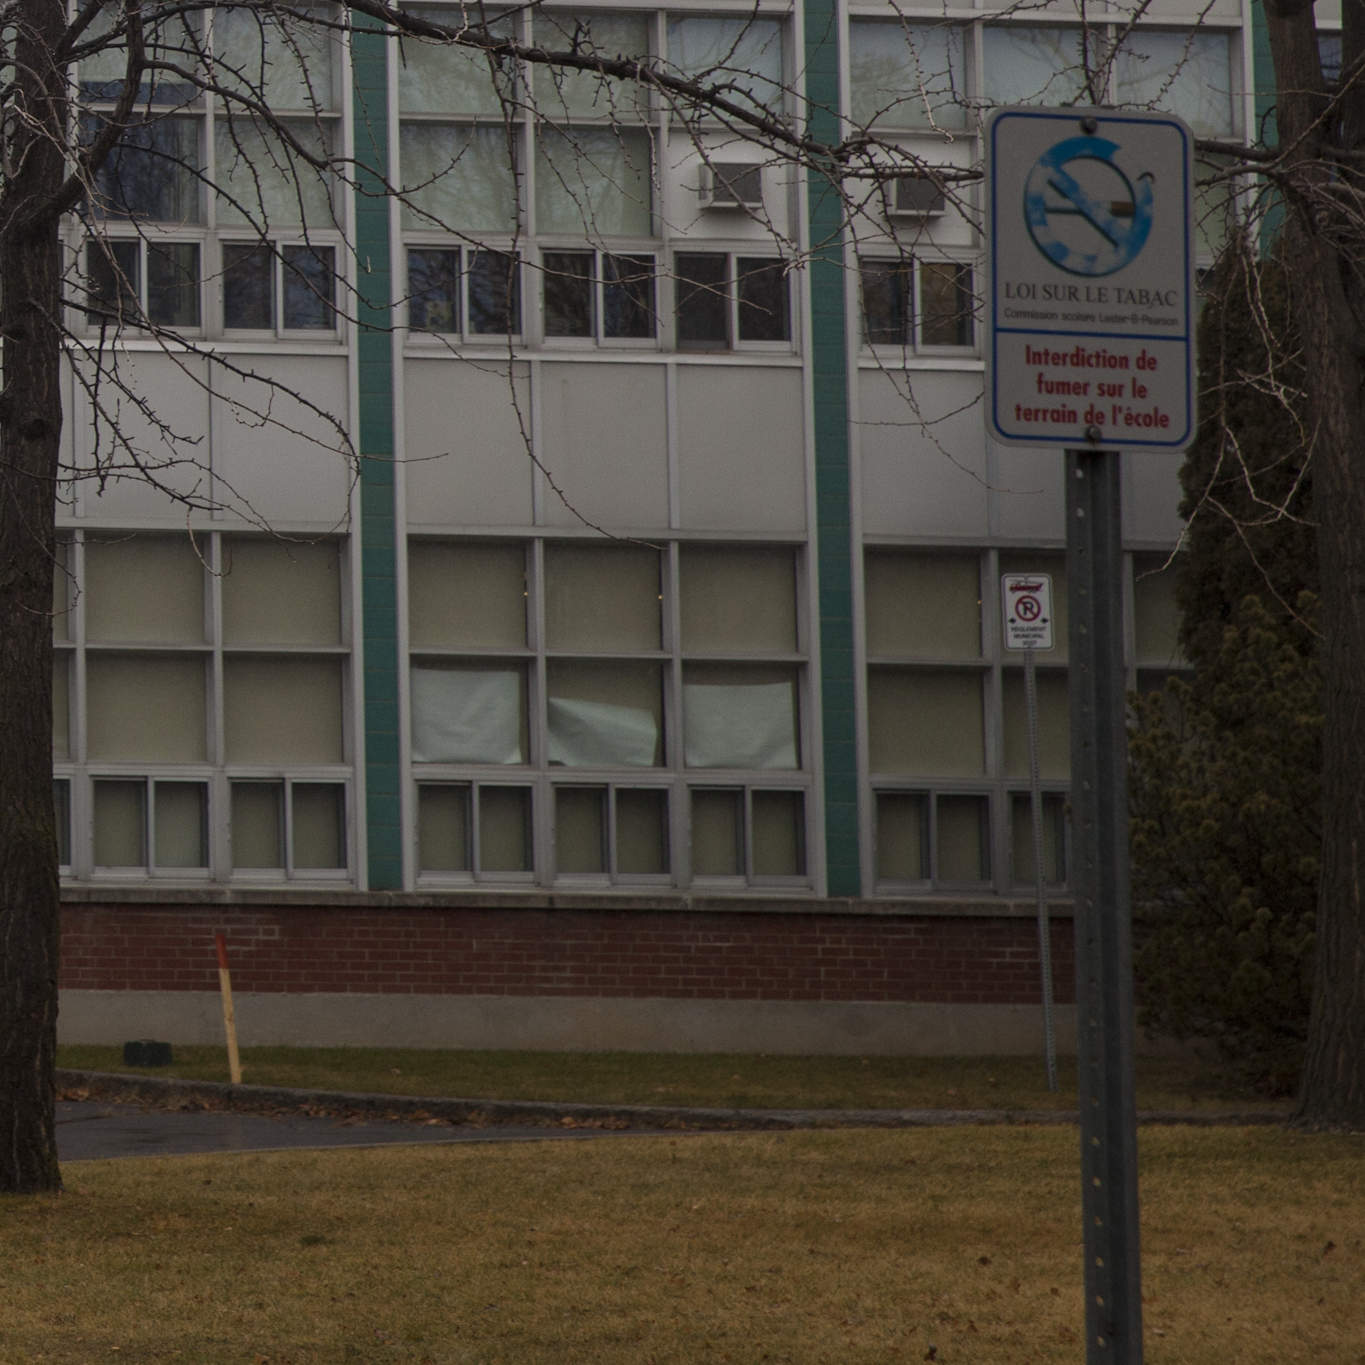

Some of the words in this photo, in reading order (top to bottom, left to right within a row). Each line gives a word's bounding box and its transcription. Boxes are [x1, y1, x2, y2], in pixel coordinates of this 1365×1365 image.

[1004, 282, 1036, 300] LOI
[1042, 283, 1080, 302] SUR
[1085, 286, 1108, 303] LE
[1113, 287, 1178, 307] TABAC
[1004, 308, 1058, 321] Commission
[1061, 311, 1096, 322] scolaire
[1024, 344, 1129, 370] Interdiction
[1136, 348, 1158, 371] de
[1036, 373, 1090, 397] fumer
[1097, 380, 1125, 399] sur
[1131, 376, 1148, 399] le
[1014, 403, 1077, 425] terrain
[1083, 403, 1105, 426] de
[1112, 404, 1170, 429] l'école
